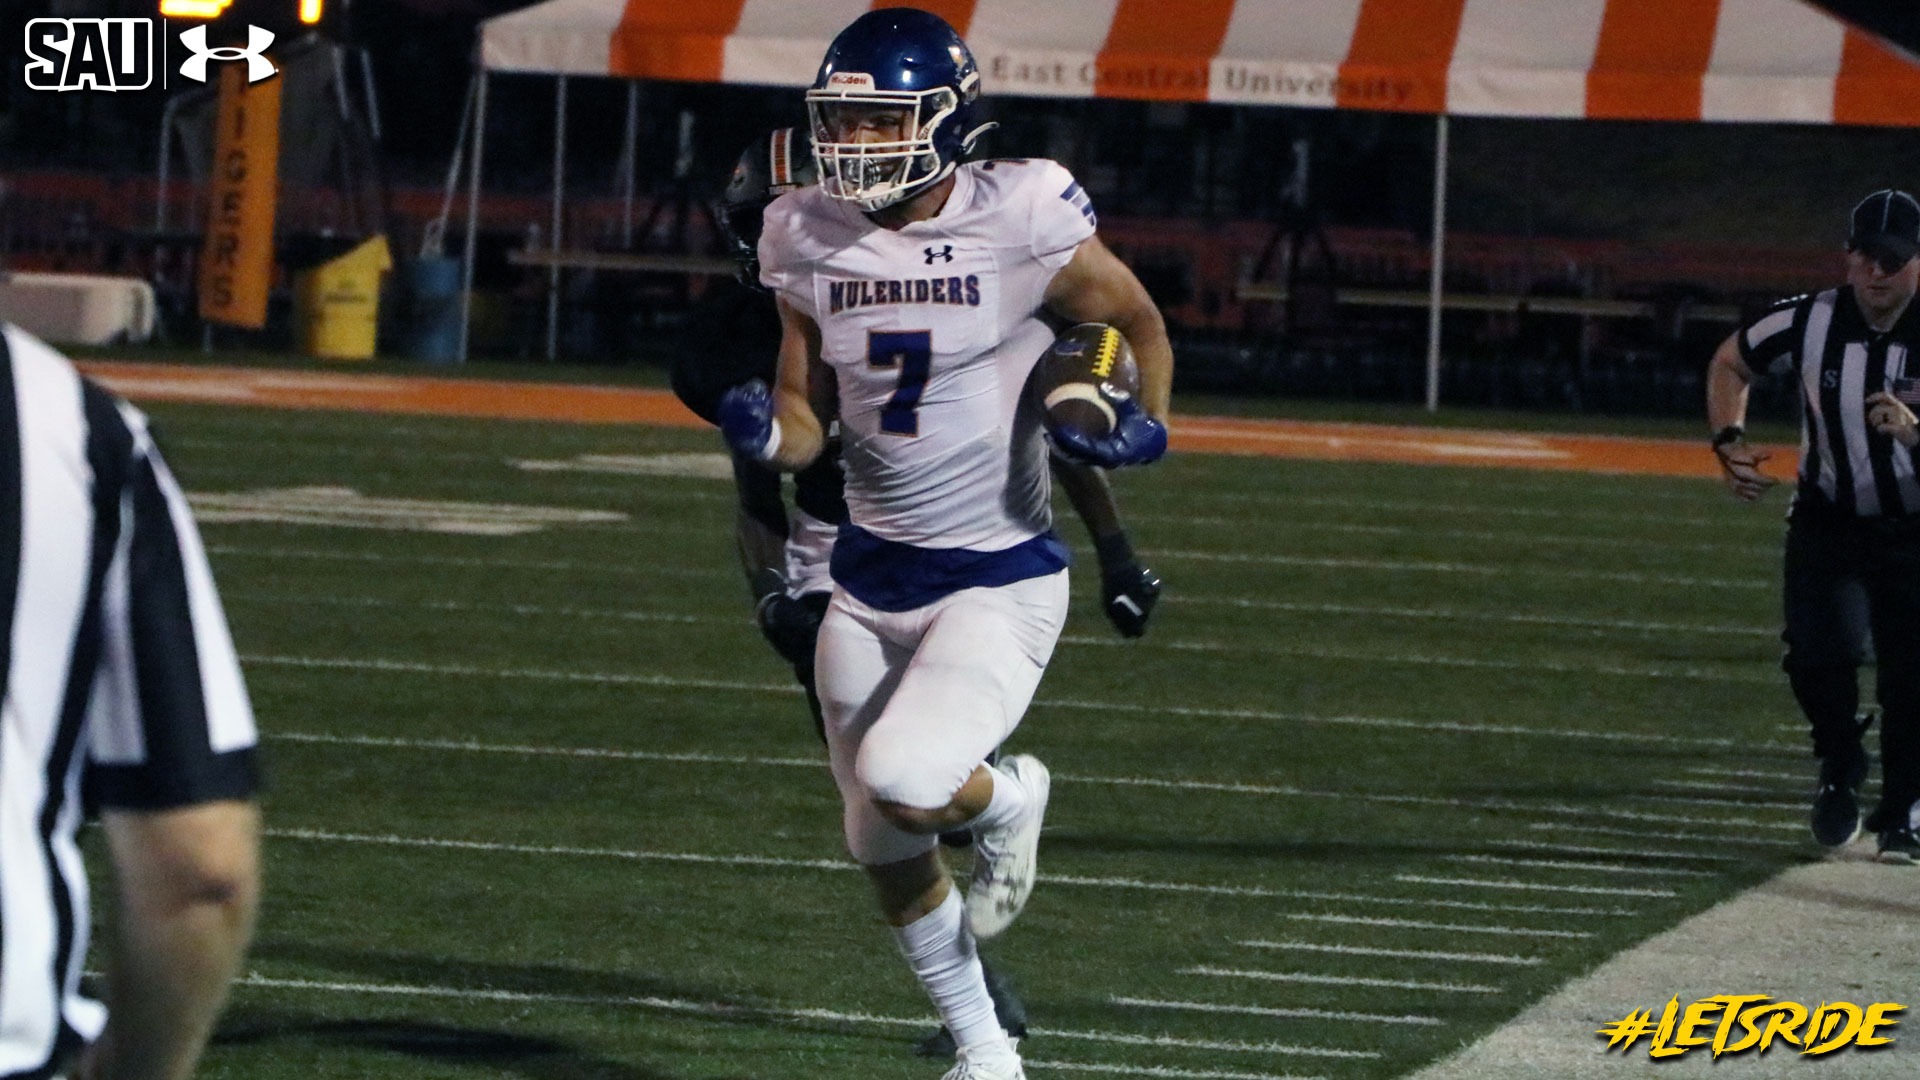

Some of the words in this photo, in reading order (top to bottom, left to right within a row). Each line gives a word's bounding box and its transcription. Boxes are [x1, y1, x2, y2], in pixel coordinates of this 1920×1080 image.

[990, 54, 1066, 85] East
[1079, 61, 1210, 91] Central
[1225, 66, 1414, 100] University
[829, 274, 981, 315] MULERIDERS
[866, 328, 932, 438] 7
[1823, 369, 1839, 388] S
